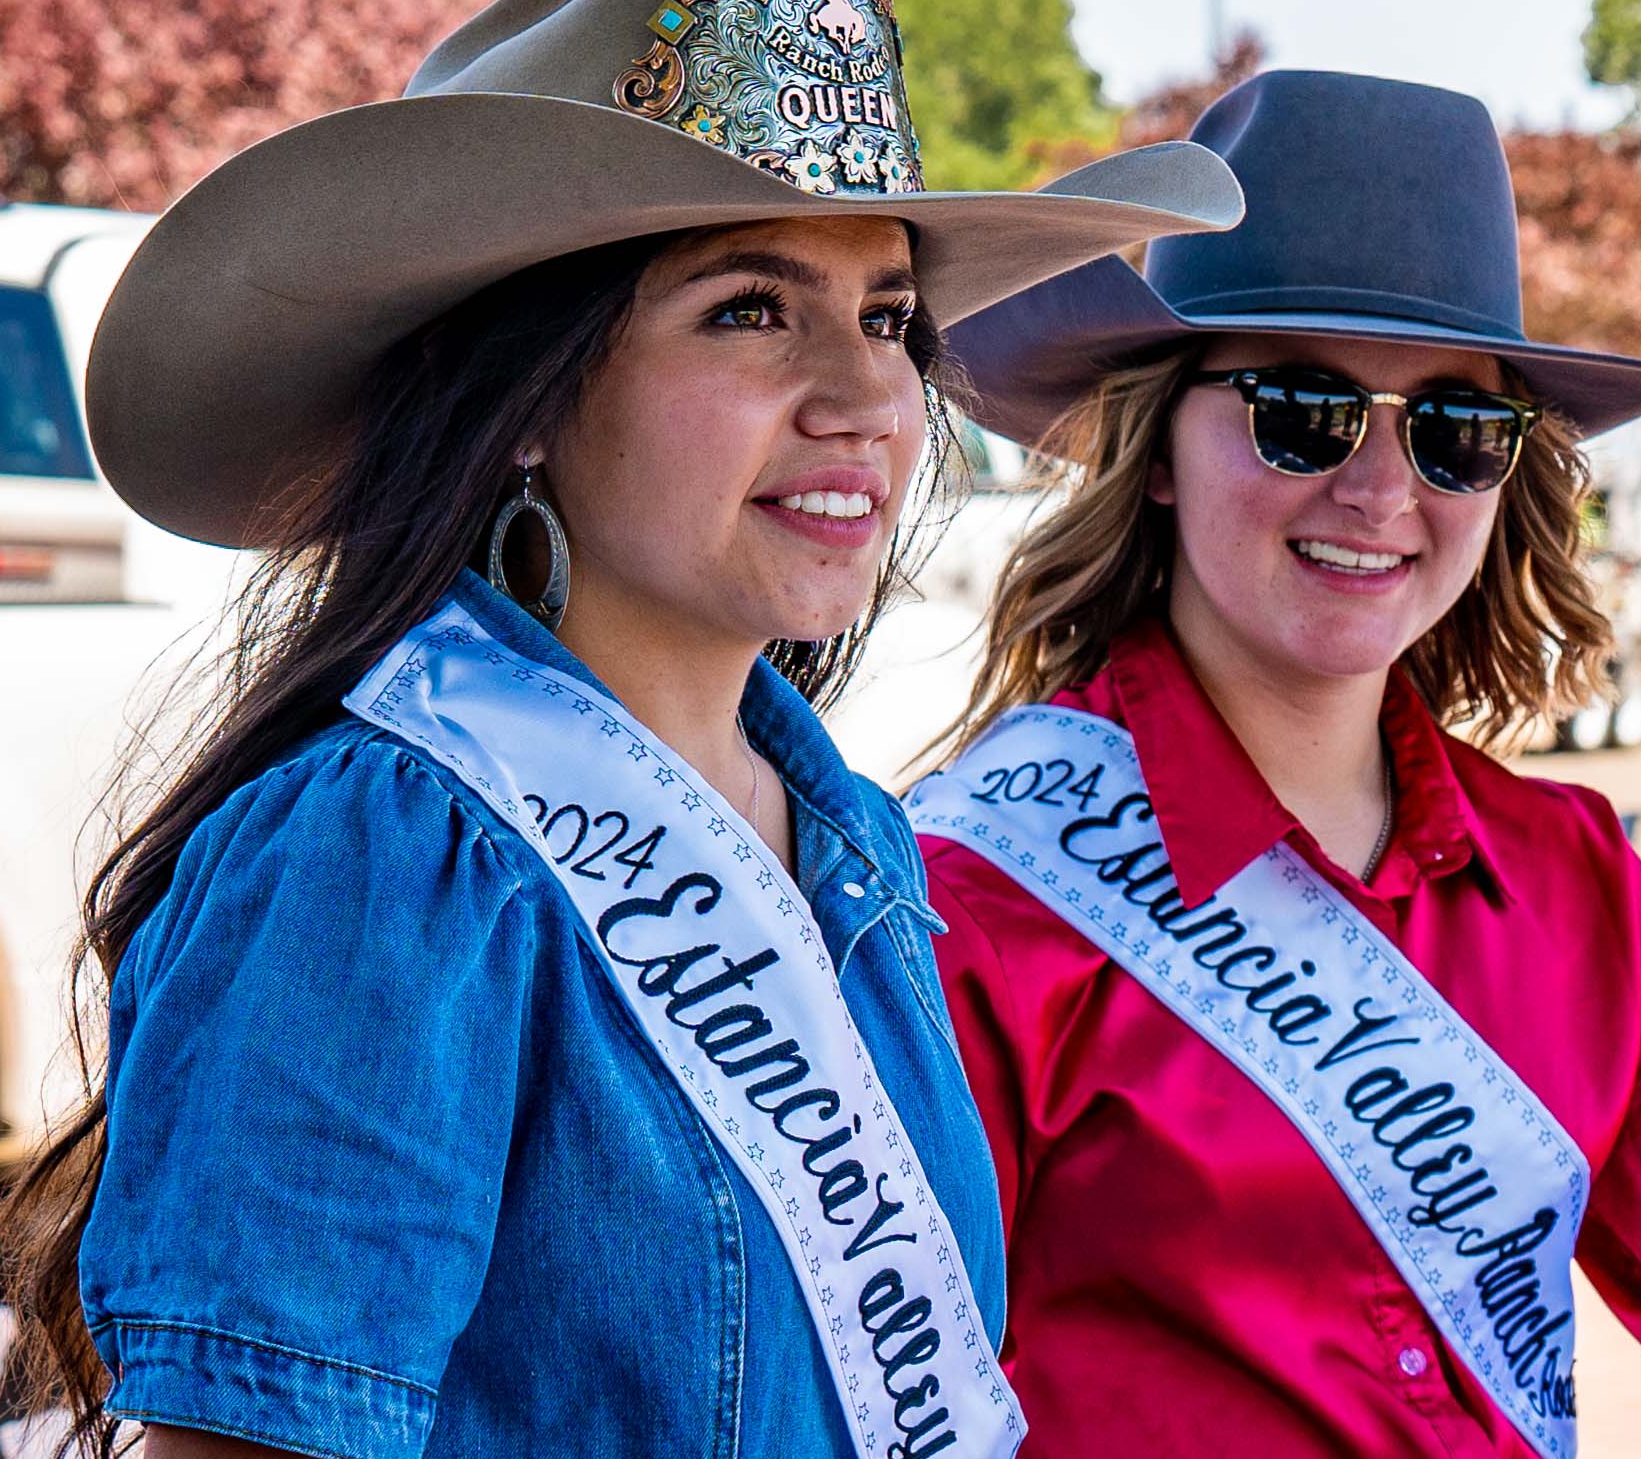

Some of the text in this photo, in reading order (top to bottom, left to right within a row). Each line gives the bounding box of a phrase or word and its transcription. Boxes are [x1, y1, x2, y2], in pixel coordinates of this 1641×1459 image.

[768, 26, 891, 83] Ranch Rodeo
[780, 85, 897, 129] QUEEN
[597, 872, 870, 1226] Estancia
[971, 759, 1106, 813] 2024
[1314, 997, 1498, 1232] Valley
[1456, 1207, 1573, 1389] Ranch
